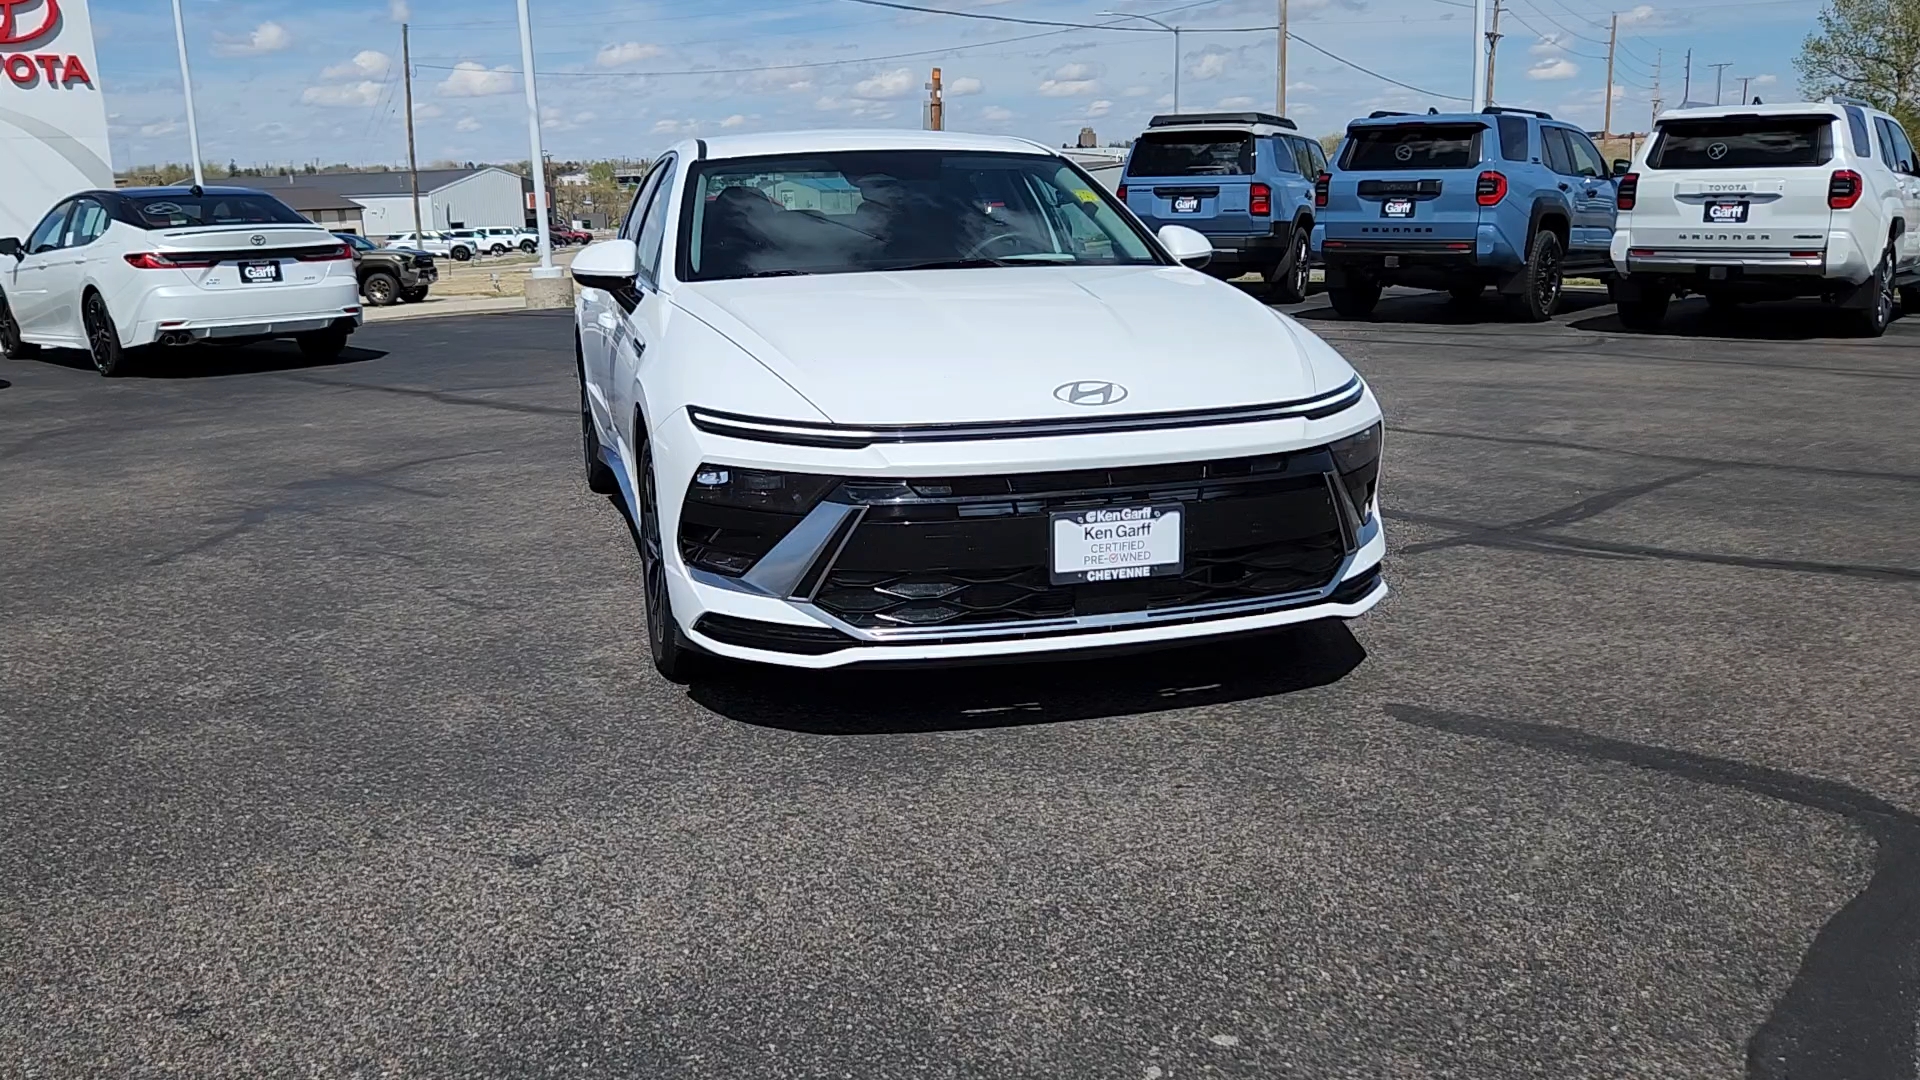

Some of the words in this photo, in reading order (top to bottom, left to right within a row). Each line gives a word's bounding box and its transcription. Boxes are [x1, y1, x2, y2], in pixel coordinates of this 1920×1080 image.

[0, 53, 92, 86] OTA
[1174, 199, 1198, 210] Garff
[1385, 202, 1412, 213] Garff
[1709, 205, 1744, 218] Garff
[245, 265, 276, 278] Garff
[1097, 510, 1120, 521] Ken
[1121, 507, 1151, 520] Garff
[1084, 527, 1113, 540] Ken
[1116, 522, 1151, 538] Garff
[1091, 541, 1145, 553] CERTIFIED
[1087, 567, 1150, 581] CHEYENNE
